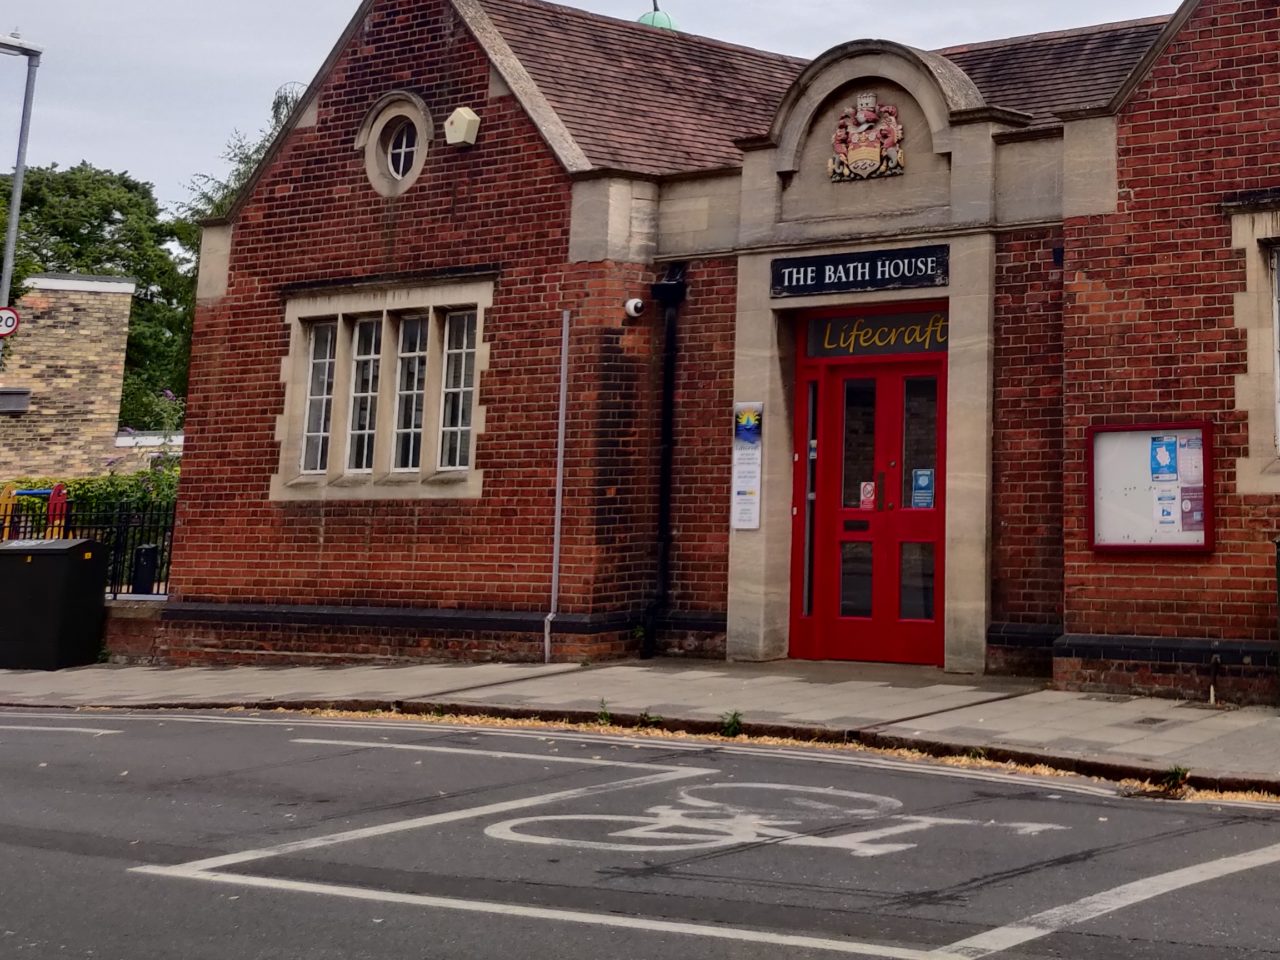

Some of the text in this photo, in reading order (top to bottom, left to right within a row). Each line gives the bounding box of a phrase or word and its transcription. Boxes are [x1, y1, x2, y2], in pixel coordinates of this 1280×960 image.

[781, 257, 937, 286] THE BATH HOUSE
[824, 313, 949, 353] Lifecraft
